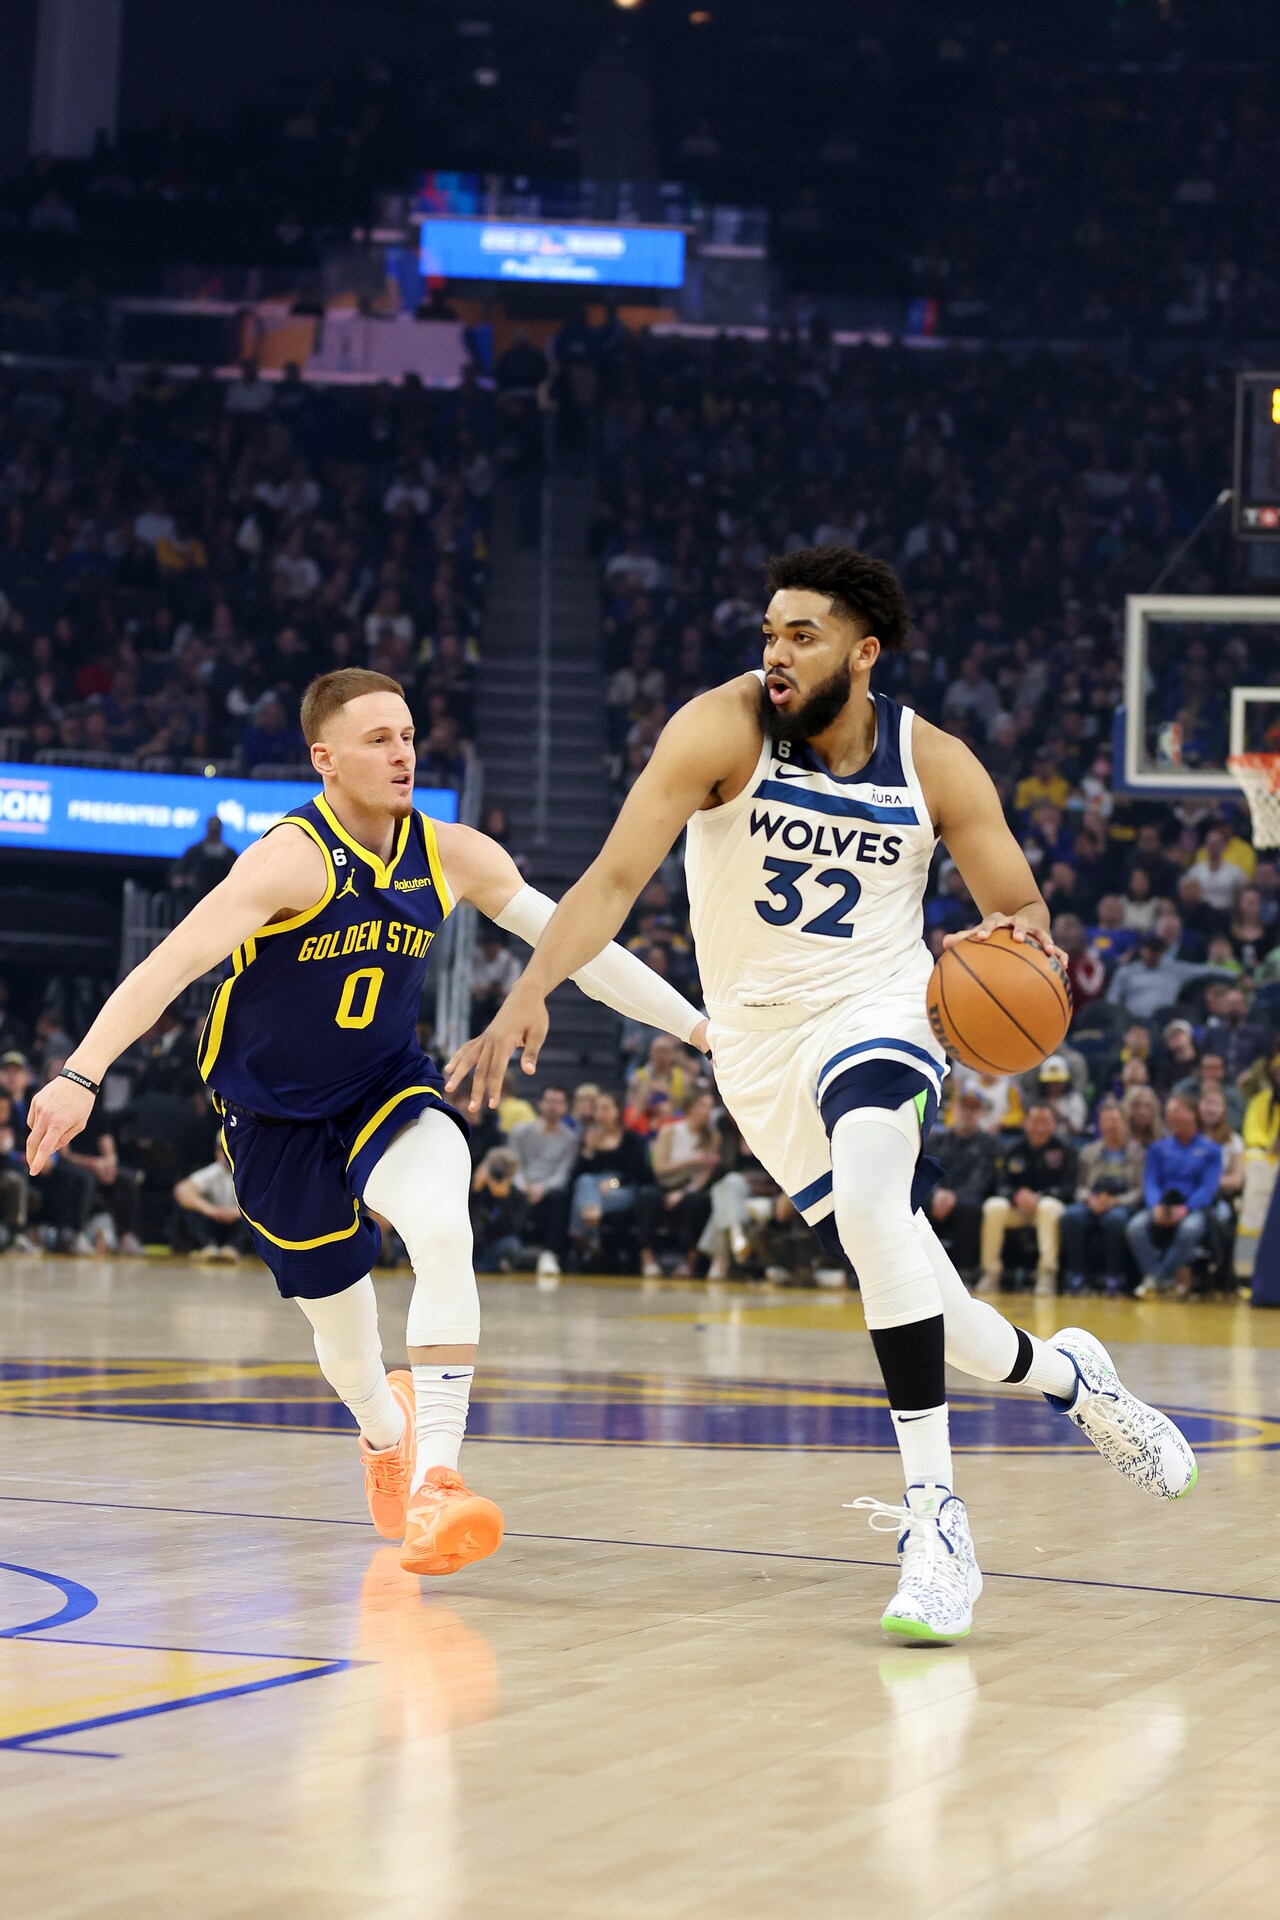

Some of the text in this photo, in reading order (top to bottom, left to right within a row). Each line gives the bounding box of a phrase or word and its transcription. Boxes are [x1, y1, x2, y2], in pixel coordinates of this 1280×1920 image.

[778, 740, 791, 758] 6
[750, 808, 903, 866] WOLVES
[332, 848, 347, 866] 6
[393, 877, 432, 893] Rakuten
[754, 855, 862, 939] 32
[298, 920, 436, 962] GOLDEN STAT
[335, 967, 385, 1030] 0
[67, 1071, 92, 1088] Blessed
